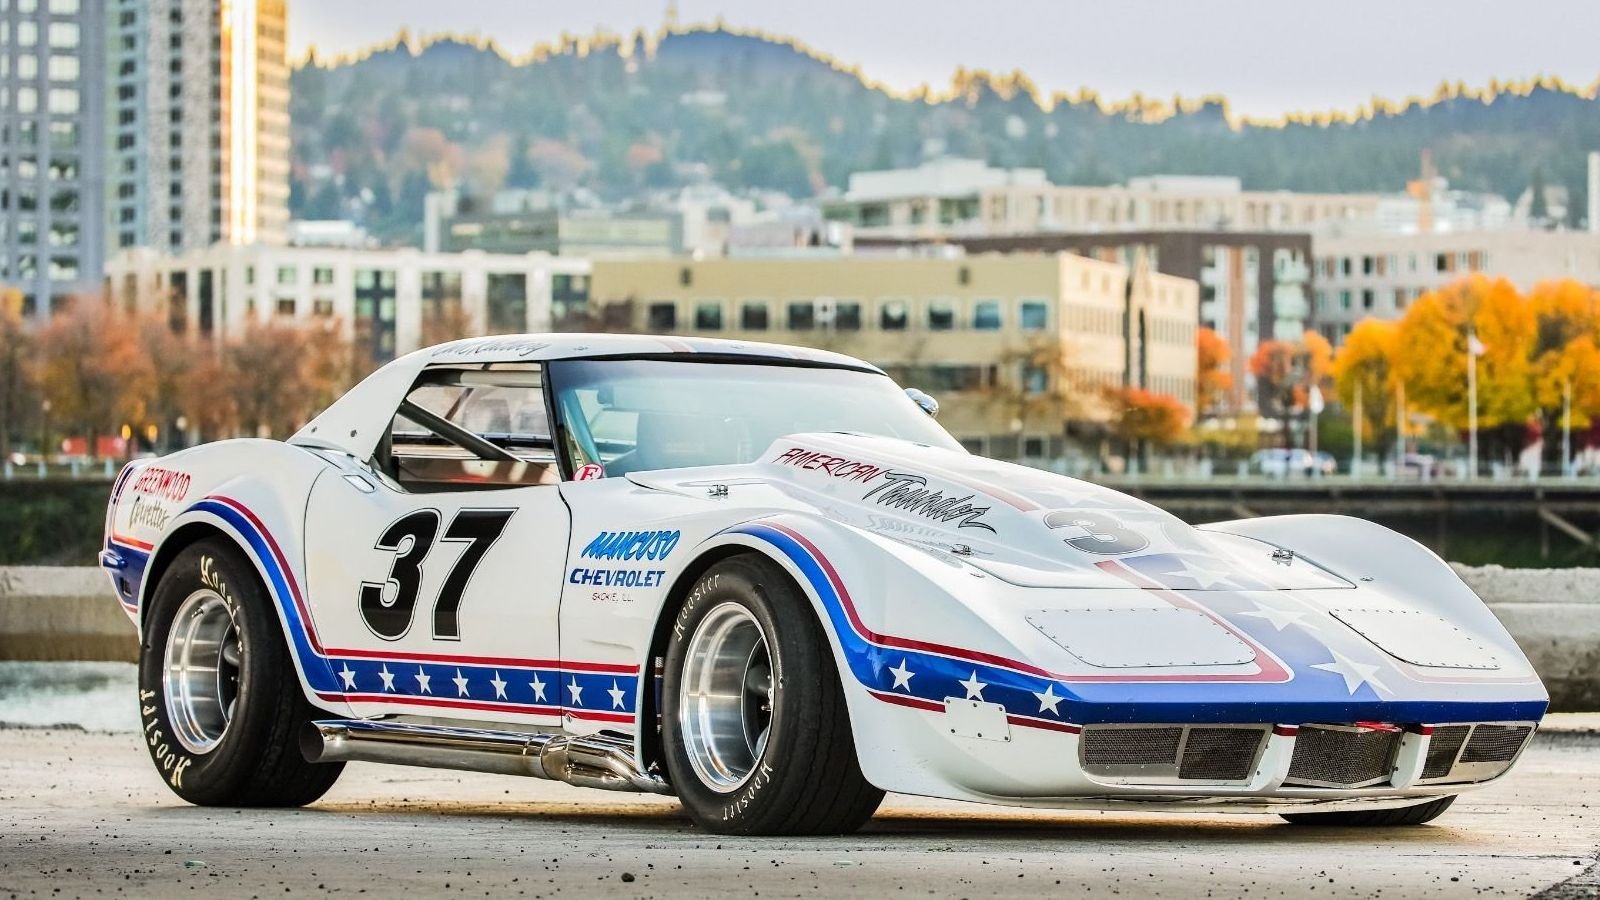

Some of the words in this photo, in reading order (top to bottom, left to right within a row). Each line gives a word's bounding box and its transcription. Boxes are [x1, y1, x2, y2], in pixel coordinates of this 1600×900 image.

[133, 467, 191, 501] GREENWOOD
[771, 448, 893, 483] AMERICAN
[581, 529, 681, 561] MANCUSO
[357, 506, 520, 642] 37
[569, 568, 666, 587] CHEVROLET
[674, 573, 721, 643] Hoosier
[140, 688, 191, 789] Hoosier
[722, 759, 774, 822] Hoosier
